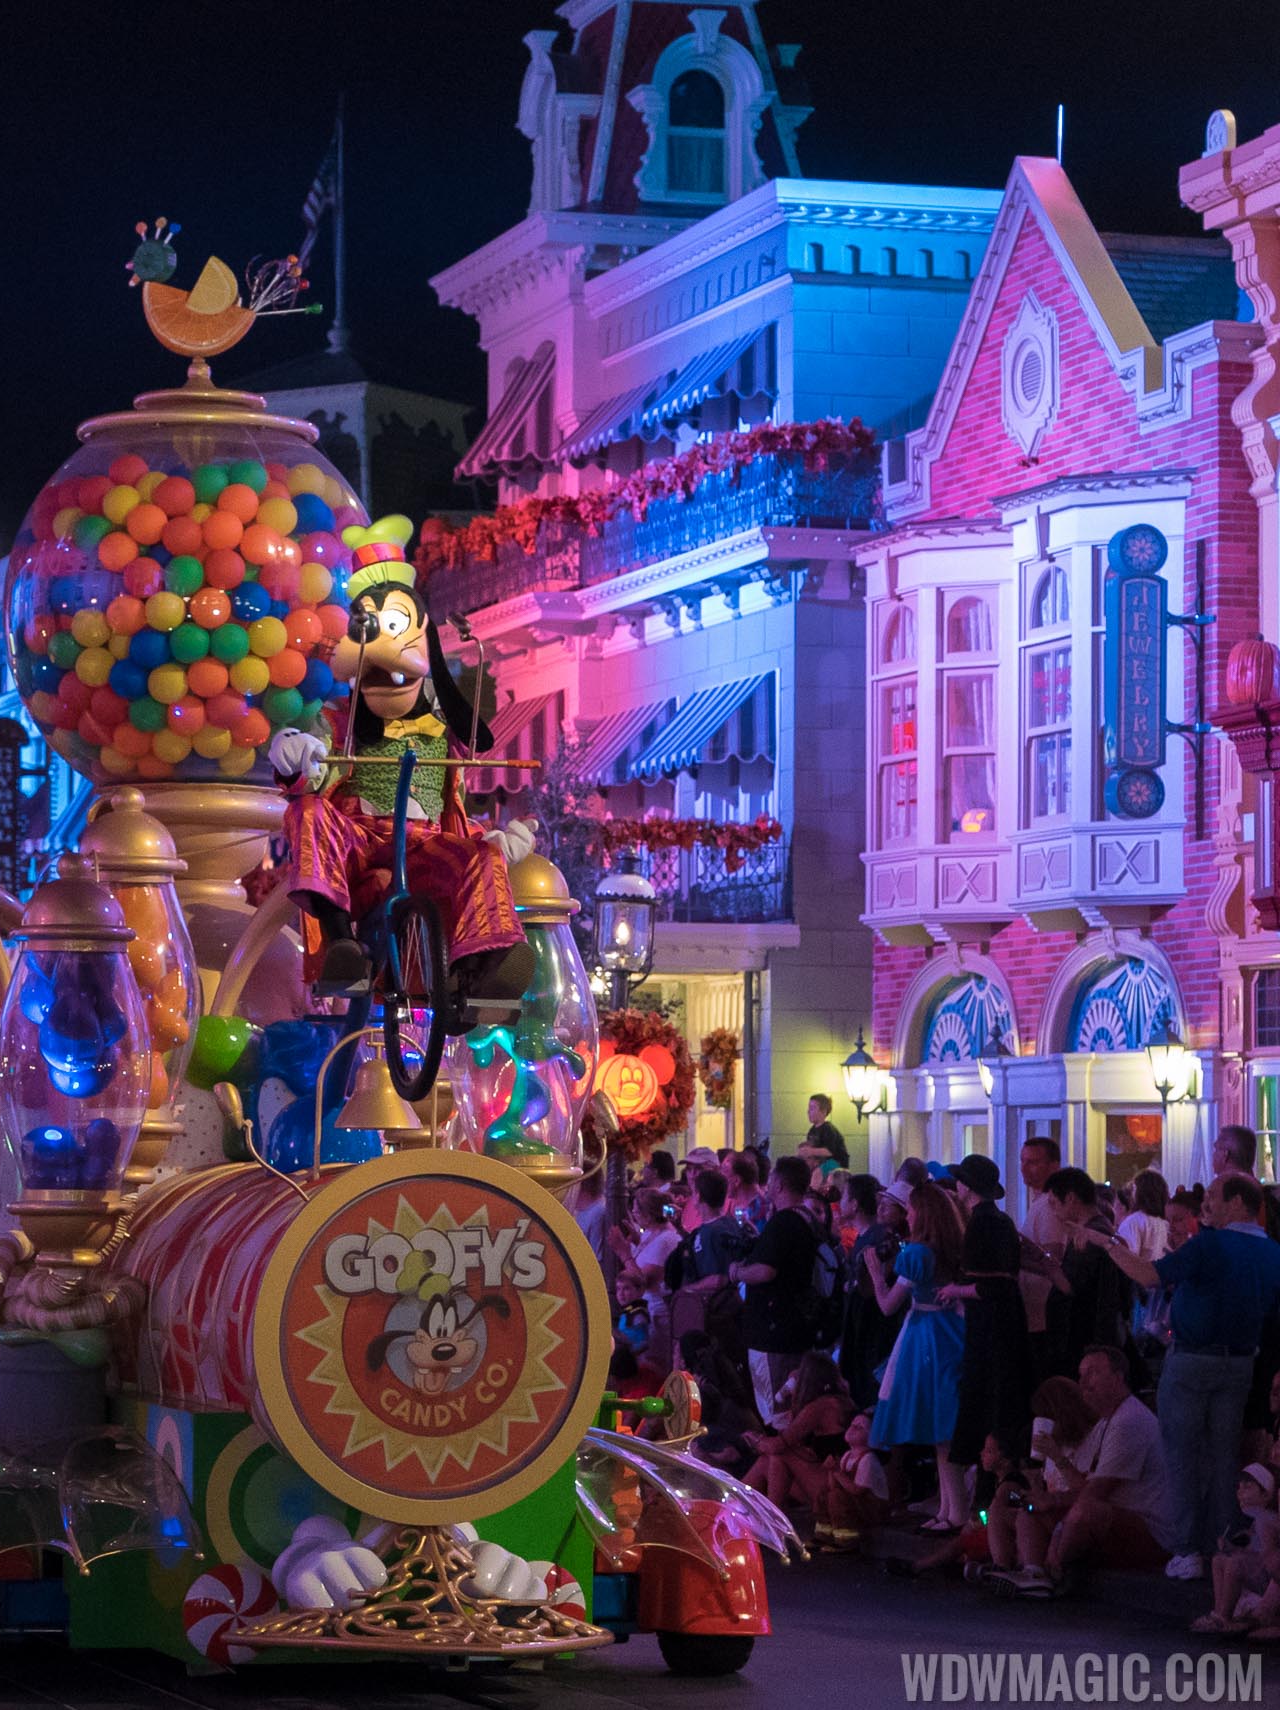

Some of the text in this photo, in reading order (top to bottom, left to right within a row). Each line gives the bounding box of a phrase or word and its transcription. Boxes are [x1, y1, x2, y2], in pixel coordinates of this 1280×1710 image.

[1128, 585, 1151, 759] JEWELRY
[379, 1358, 514, 1428] CANDY CO.
